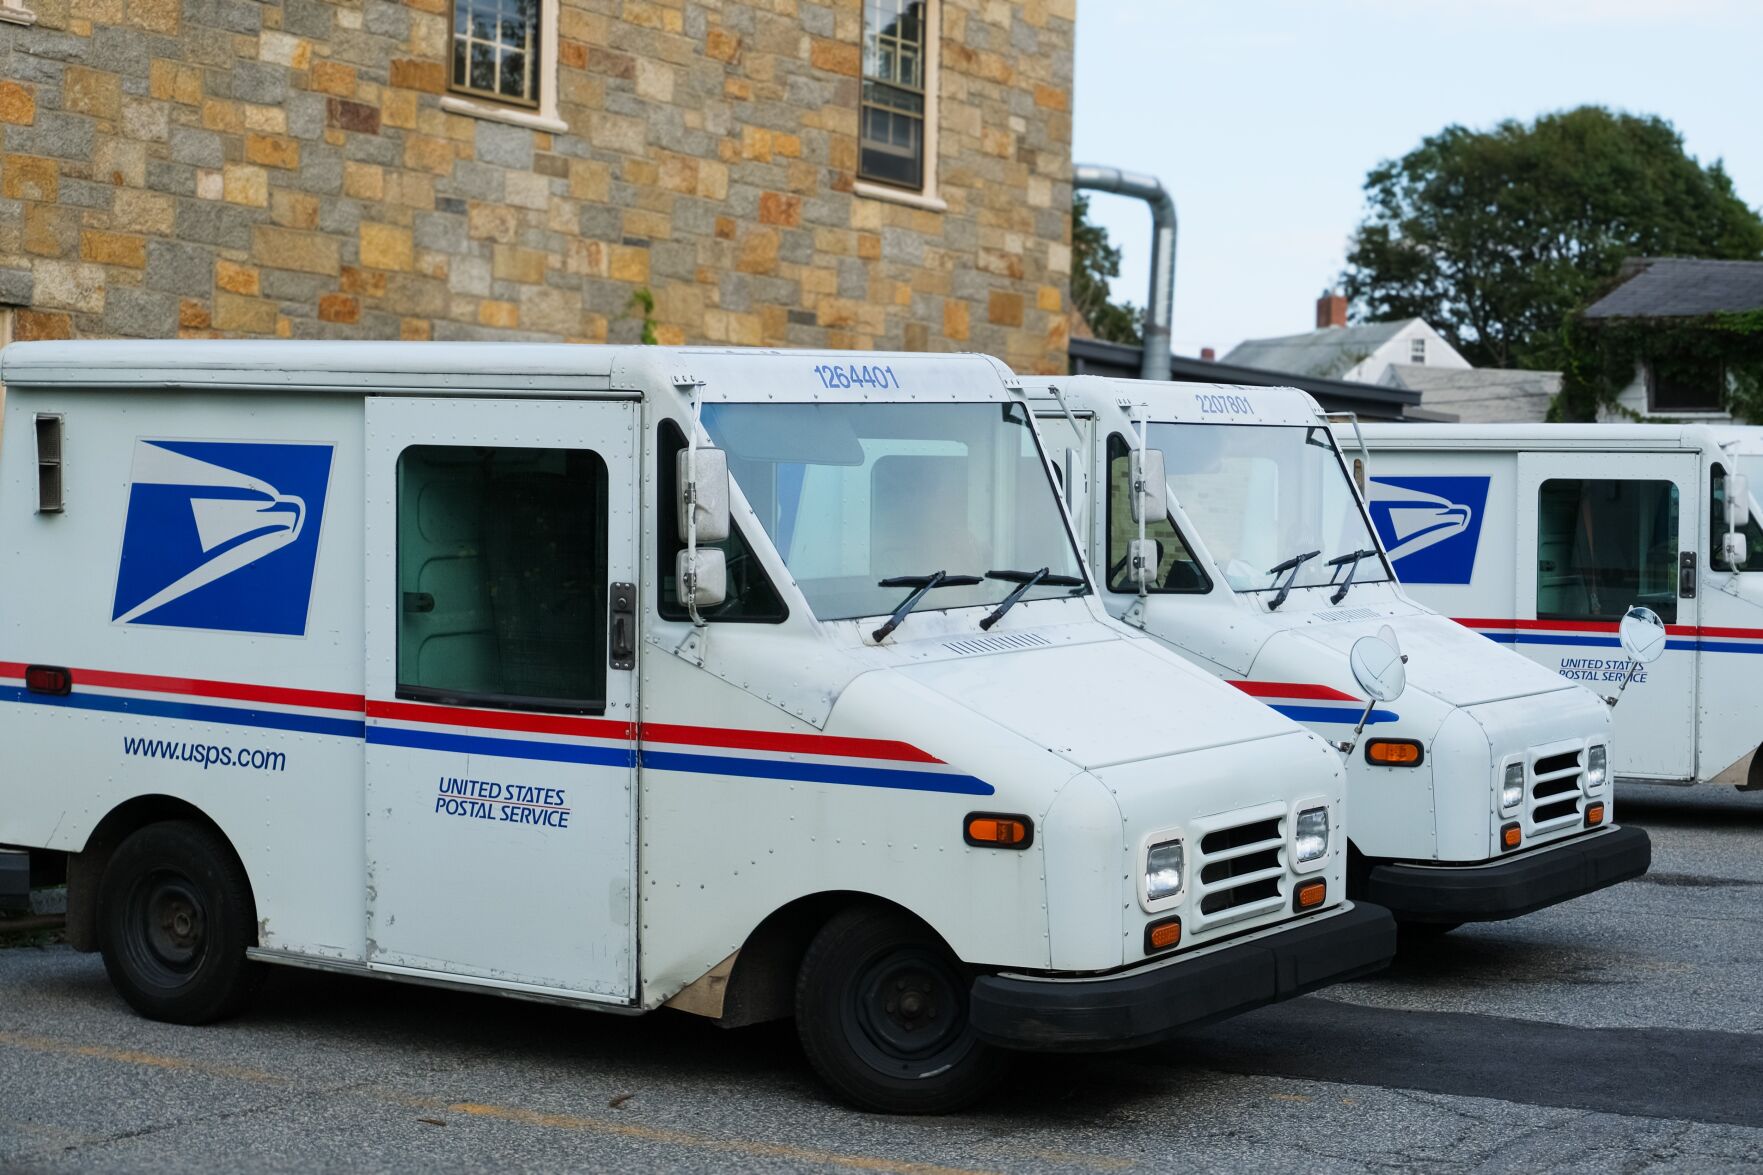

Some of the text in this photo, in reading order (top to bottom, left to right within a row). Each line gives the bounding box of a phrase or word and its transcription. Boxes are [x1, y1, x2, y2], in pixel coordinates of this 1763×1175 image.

[814, 365, 900, 389] 1264401
[1195, 394, 1255, 415] 2207801
[1559, 669, 1600, 681] POSTAL
[1560, 658, 1645, 671] UNITED STATS
[123, 736, 287, 771] www.usps.com
[438, 776, 566, 807] UNITED STATES
[435, 797, 571, 829] POSTAL SERVICE
